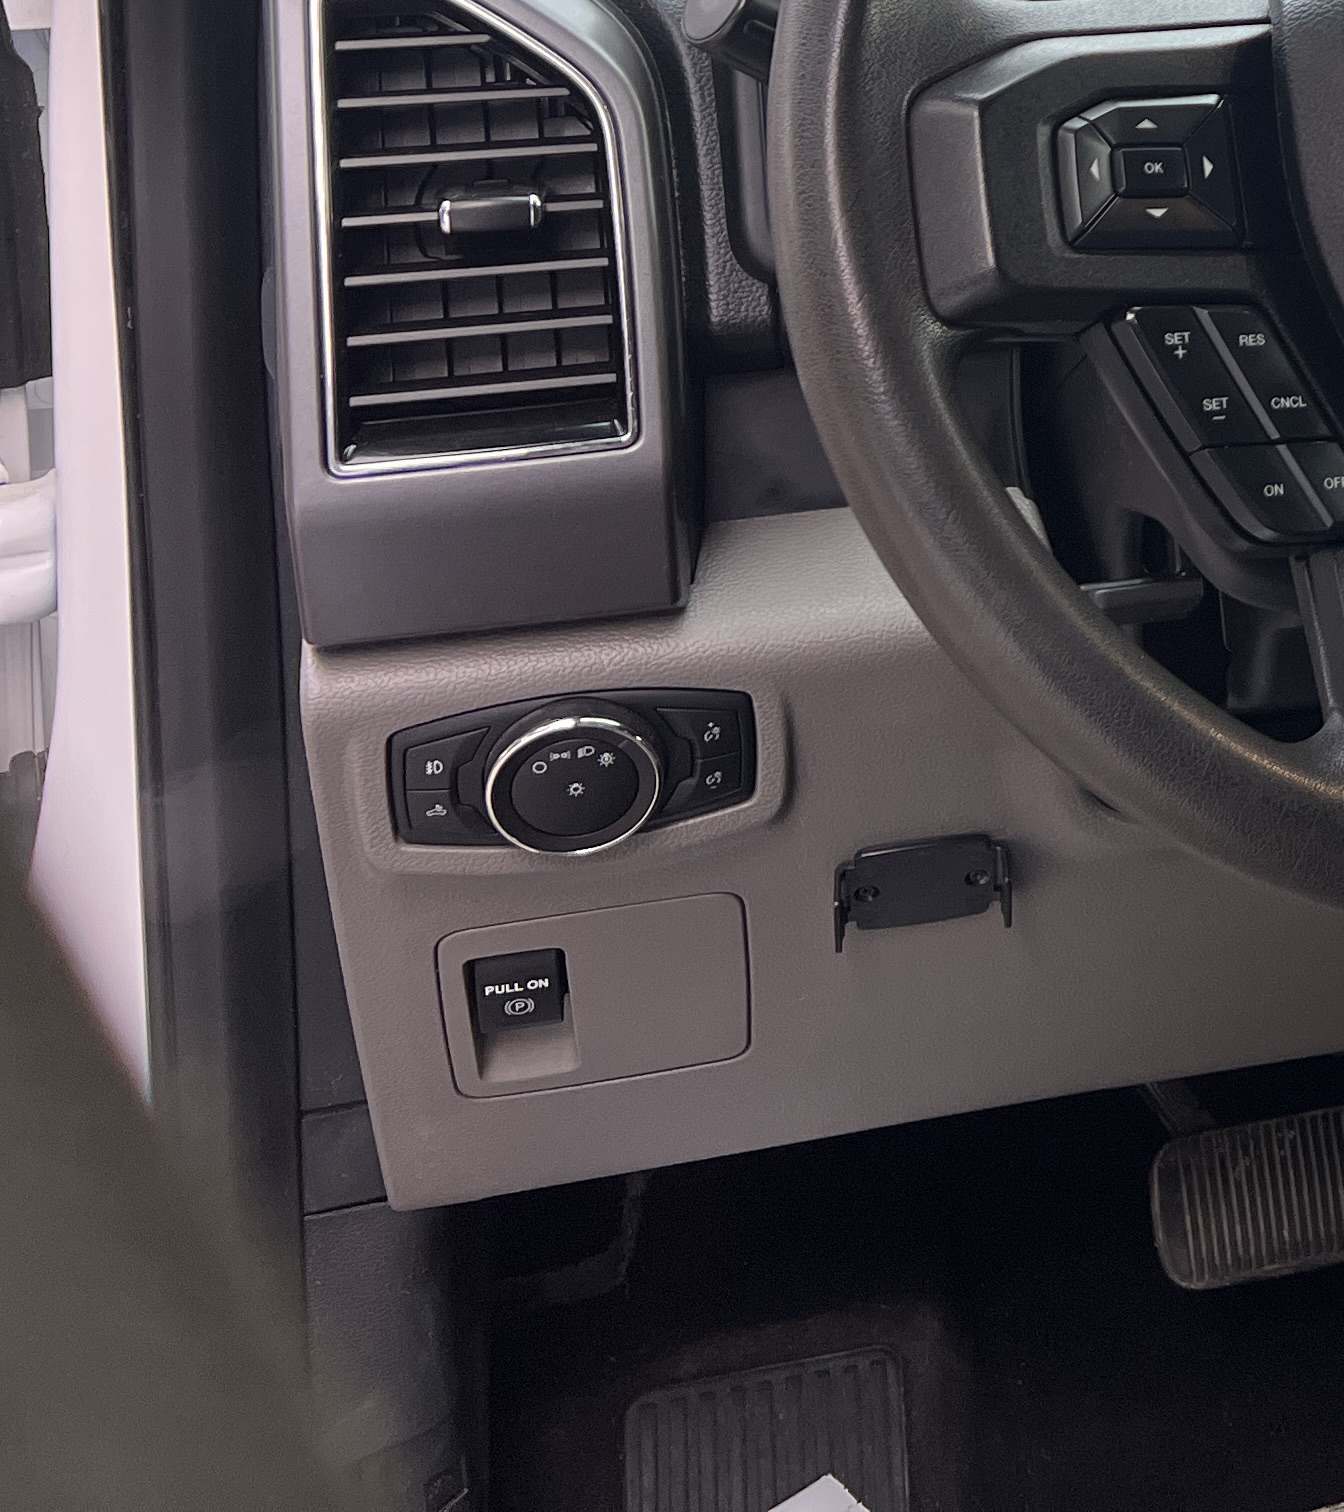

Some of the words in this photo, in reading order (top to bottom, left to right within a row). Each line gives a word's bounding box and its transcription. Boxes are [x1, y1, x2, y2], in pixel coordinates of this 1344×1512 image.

[1143, 161, 1165, 175] OK
[1164, 331, 1191, 345] SET
[1238, 333, 1266, 347] RES
[1202, 396, 1229, 411] SET
[1270, 395, 1308, 410] CNCL
[1263, 483, 1285, 497] ON
[484, 982, 524, 996] PULL
[526, 978, 549, 990] ON
